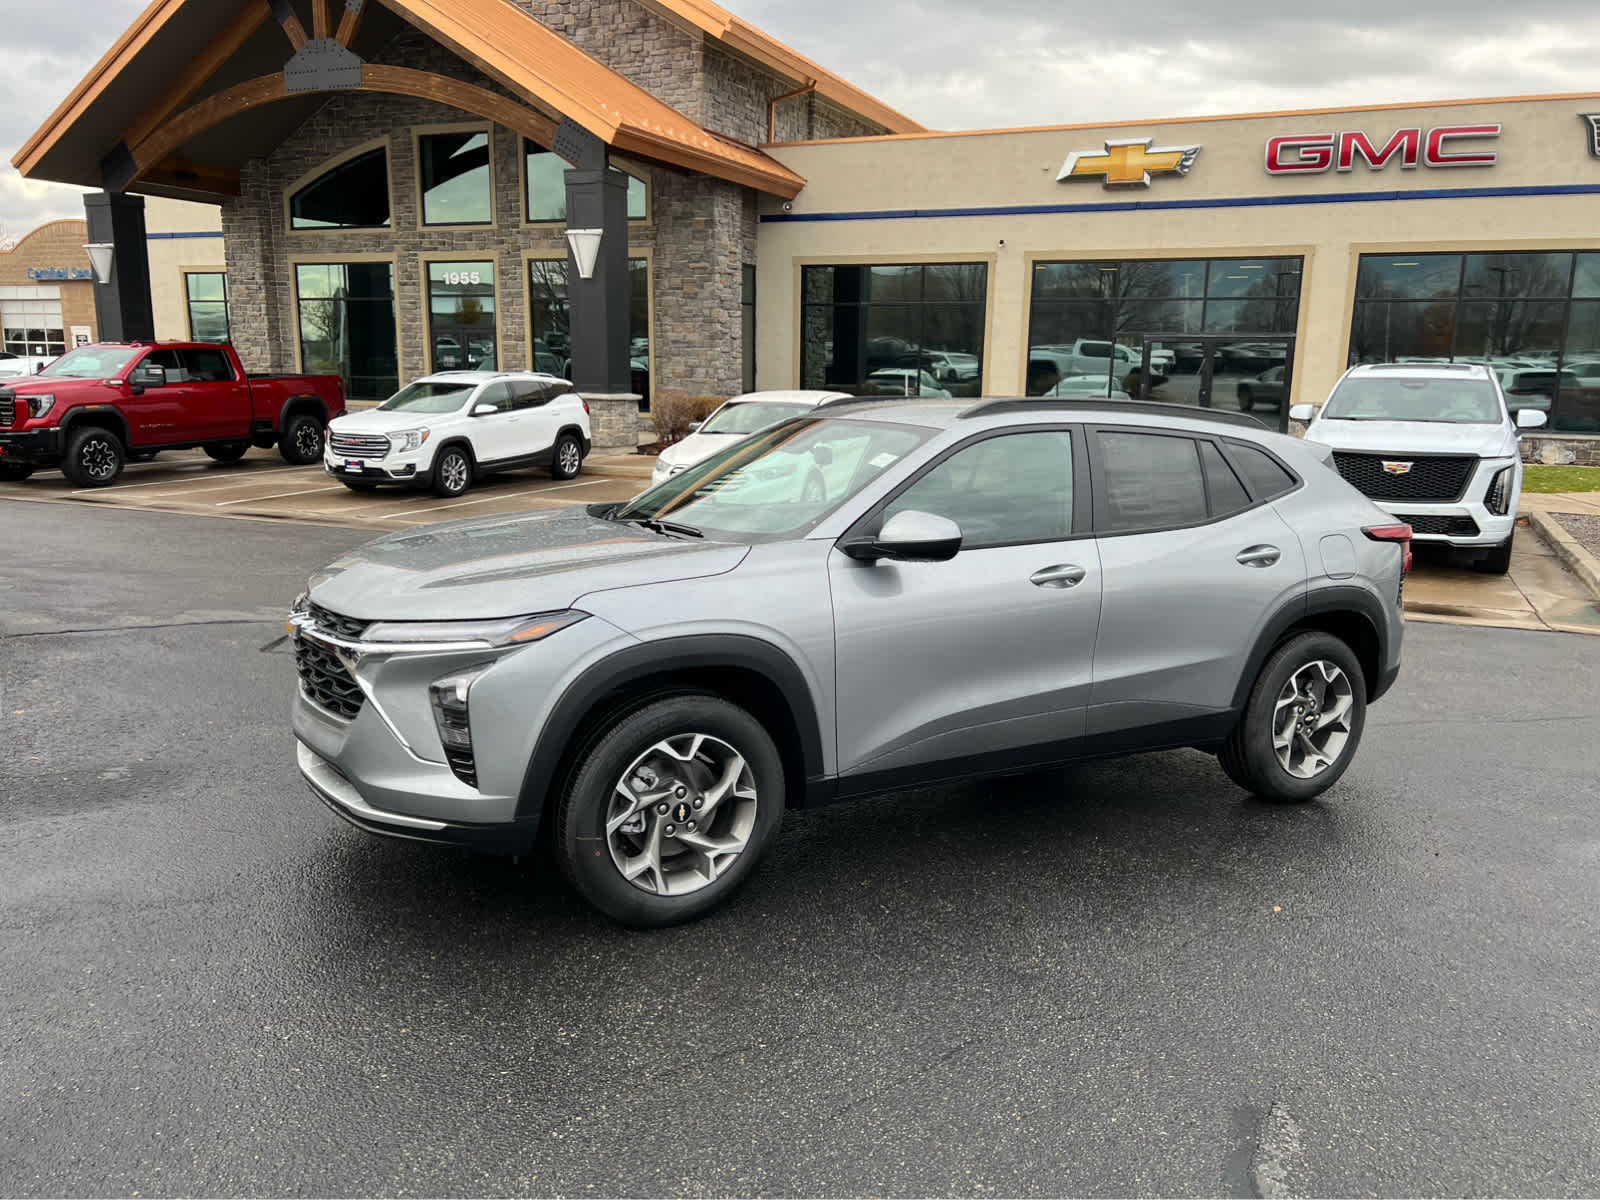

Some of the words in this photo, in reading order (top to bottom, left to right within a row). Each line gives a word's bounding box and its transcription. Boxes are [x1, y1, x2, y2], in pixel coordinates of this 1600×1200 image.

[1265, 123, 1502, 175] GMC
[27, 266, 69, 280] Certified
[442, 271, 480, 285] 1955
